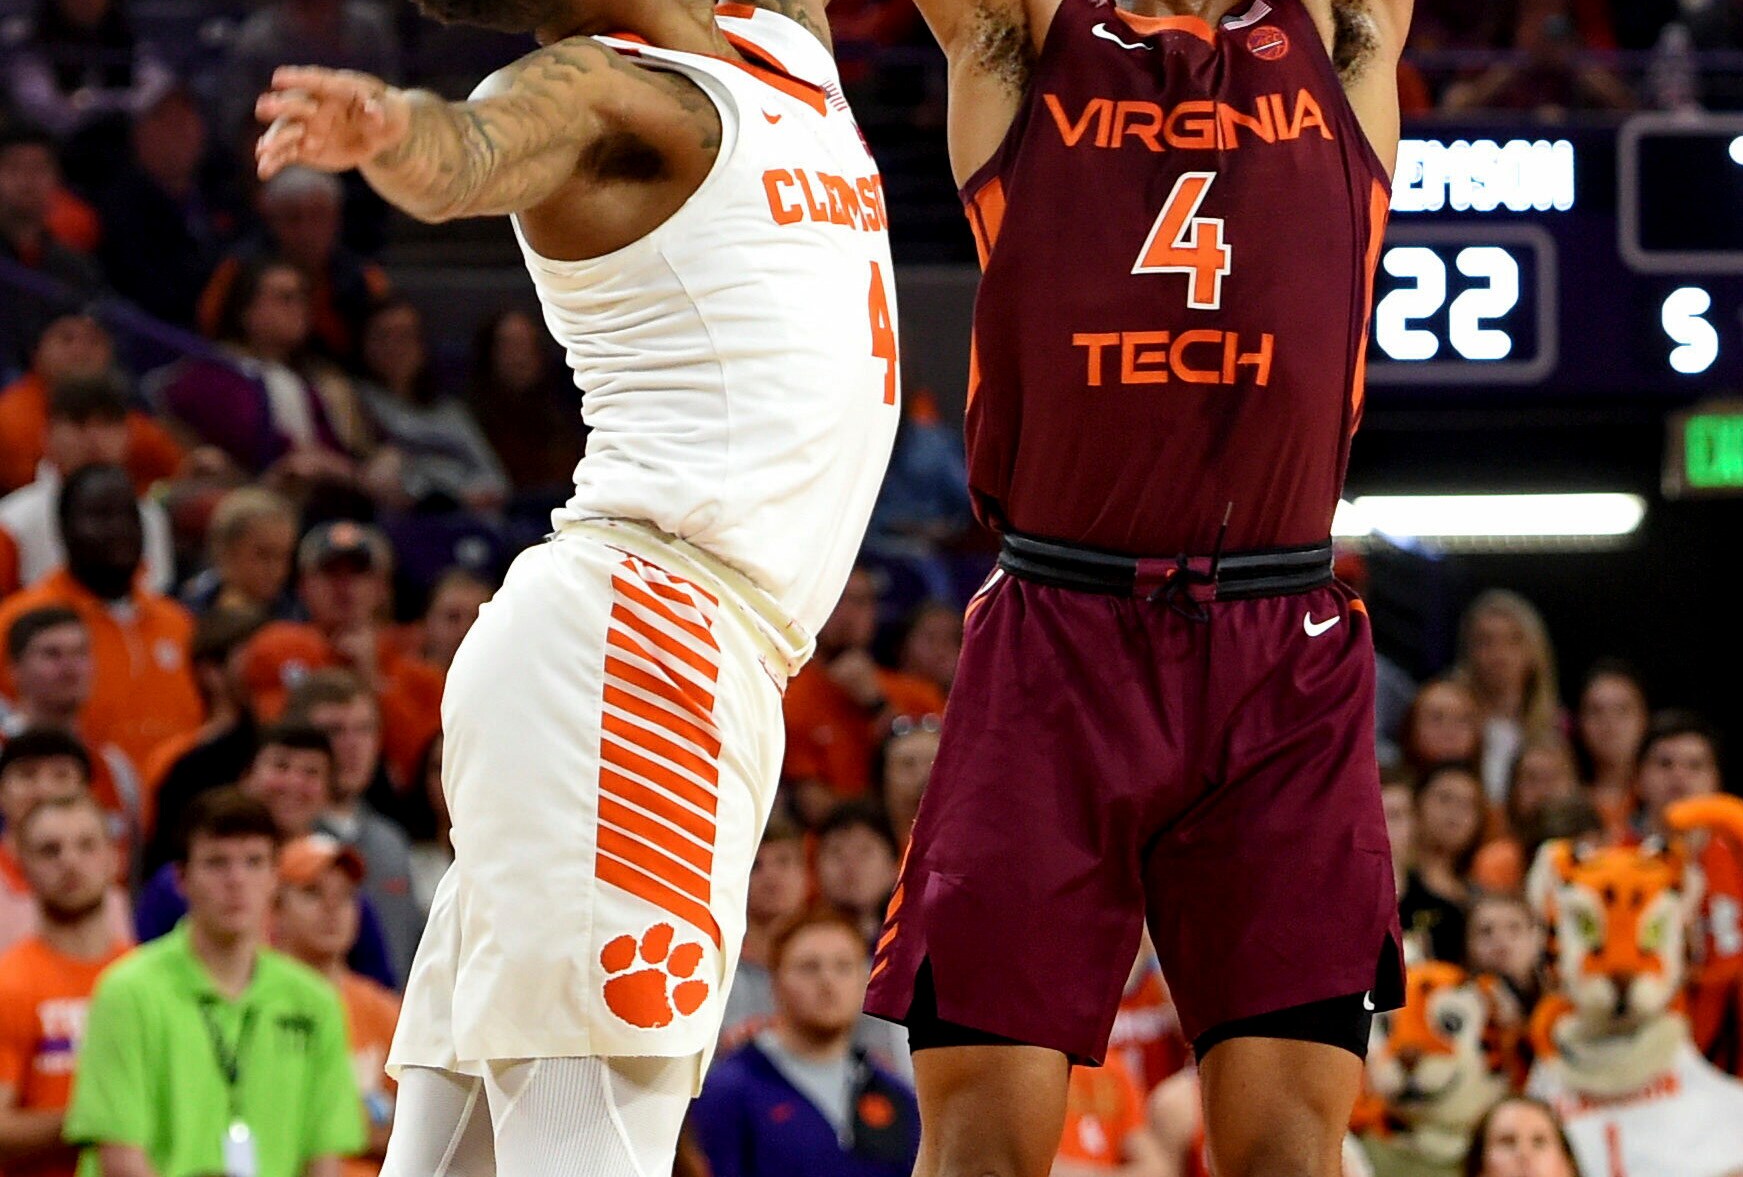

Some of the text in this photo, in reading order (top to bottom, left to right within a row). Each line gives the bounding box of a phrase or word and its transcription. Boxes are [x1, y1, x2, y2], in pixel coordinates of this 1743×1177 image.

[1043, 88, 1334, 152] VIRGINIA
[1131, 171, 1232, 310] 4
[868, 260, 897, 406] 4
[1072, 329, 1274, 386] TECH
[1376, 246, 1519, 360] 22
